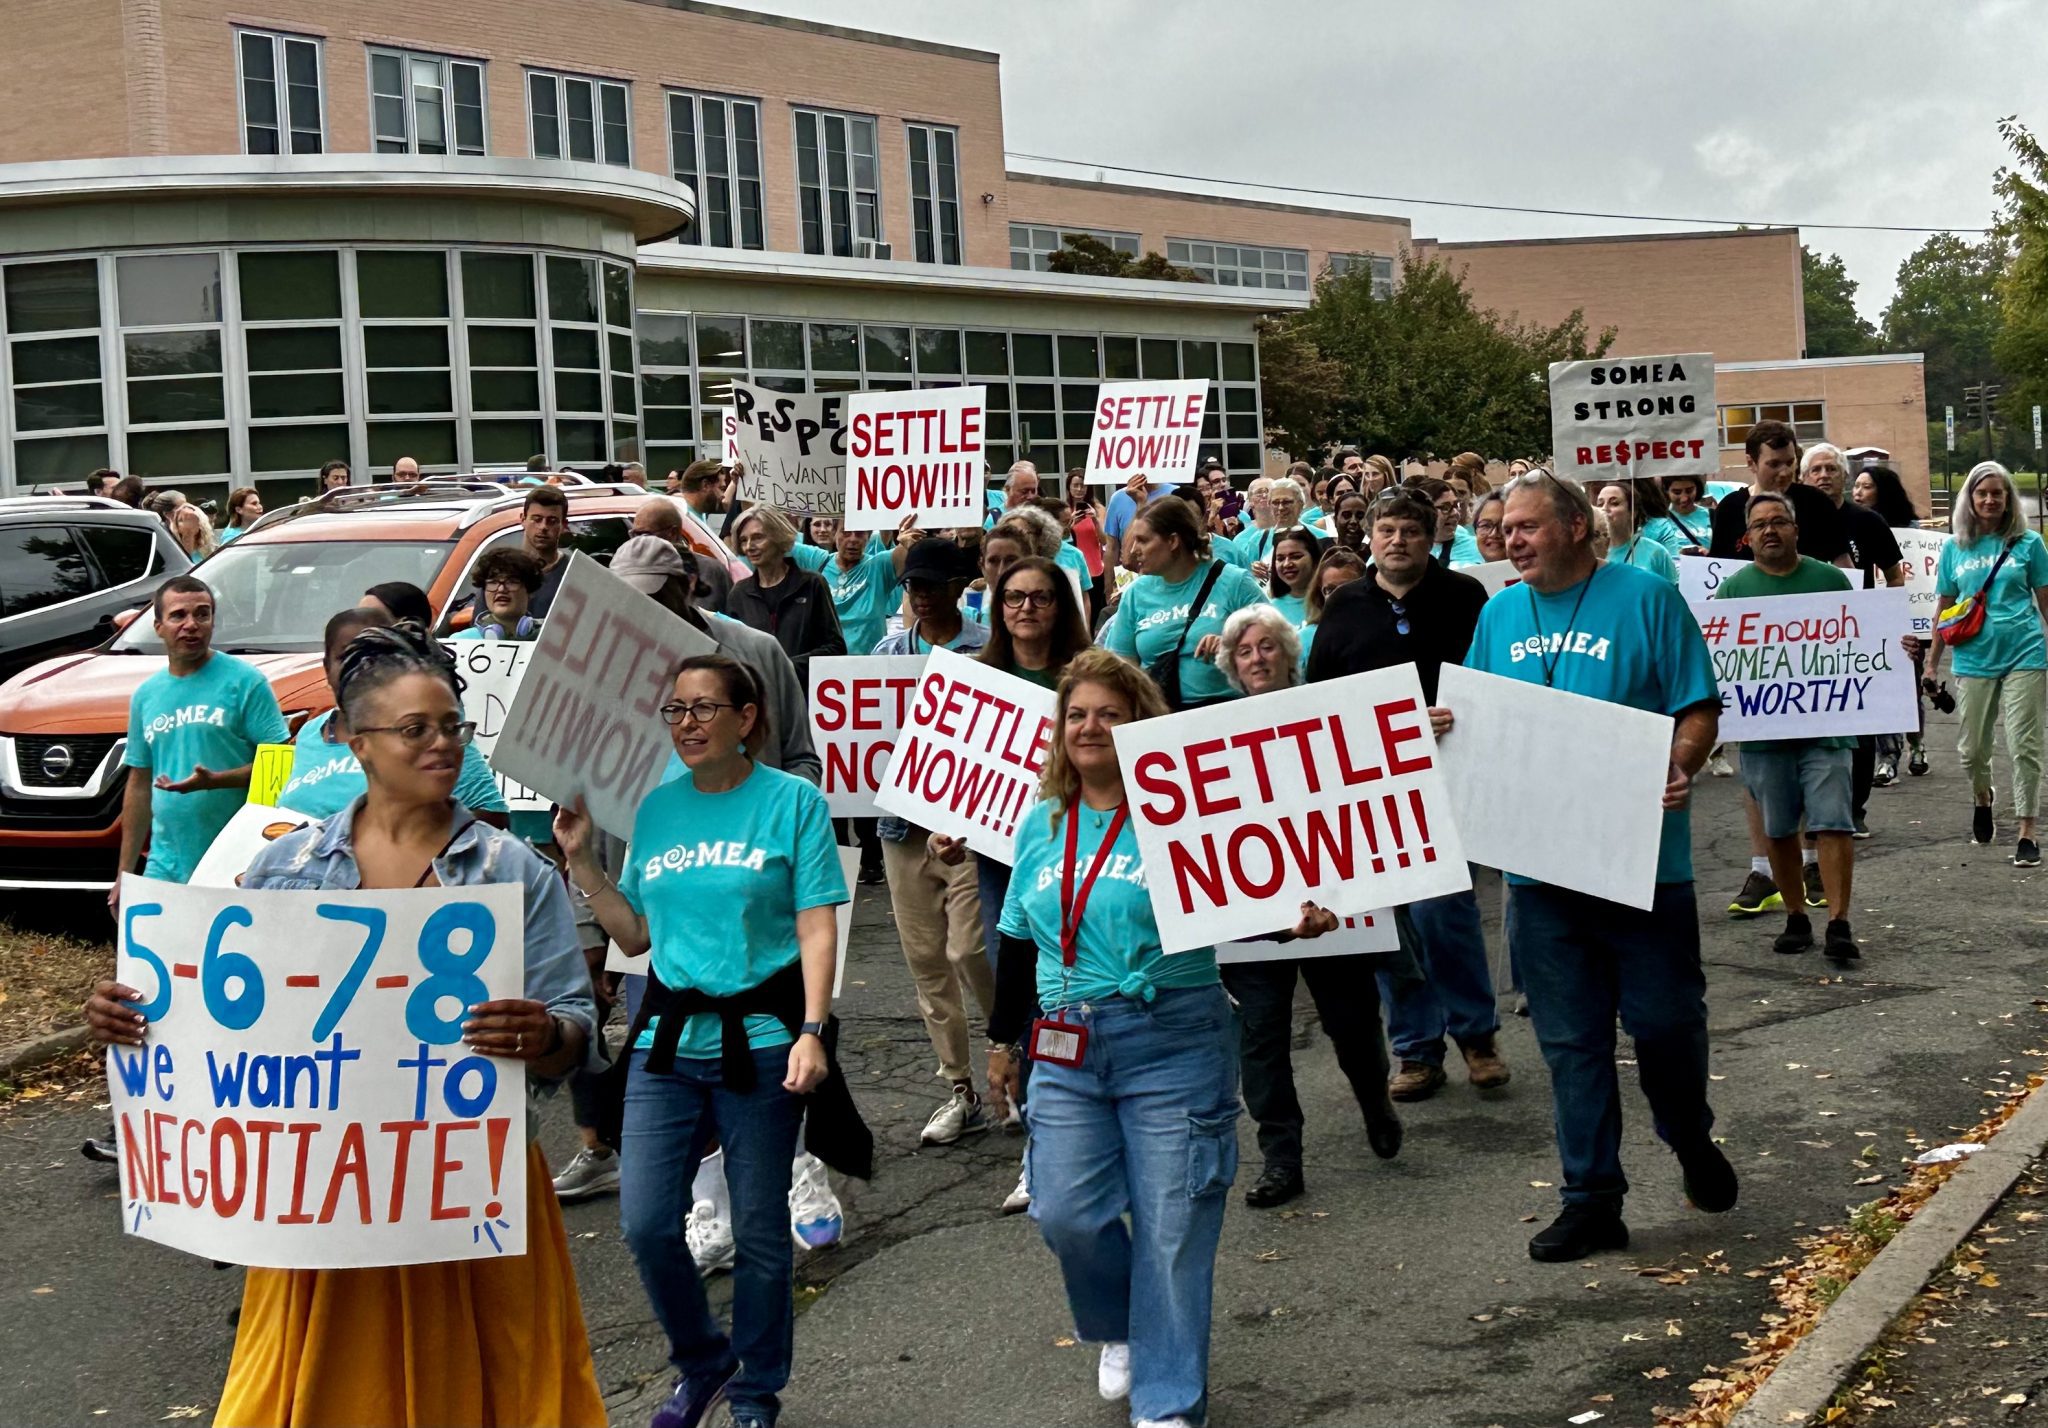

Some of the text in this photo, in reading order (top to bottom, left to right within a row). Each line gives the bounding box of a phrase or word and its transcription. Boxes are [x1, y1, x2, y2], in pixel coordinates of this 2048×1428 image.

[1591, 363, 1686, 385] SOMEA
[734, 388, 847, 456] RESPEC
[1097, 395, 1203, 430] SETTLE
[1574, 395, 1695, 420] STRONG
[852, 407, 980, 458] SETTLE
[1095, 435, 1190, 469] NOW!!!
[1577, 440, 1704, 465] RE$PECT
[744, 450, 845, 485] WE WANT
[857, 462, 971, 510] NOW!!!
[740, 477, 846, 513] WE DESERVE
[1136, 603, 1217, 632] SOMA
[1714, 639, 1892, 682] SOMEA United
[144, 704, 224, 744] SOMEA
[815, 679, 921, 731] SET
[914, 672, 1056, 774] SETTLE
[285, 756, 364, 794] SOME
[1134, 698, 1433, 826] SETTLE
[895, 736, 1029, 837] NOW!!!
[645, 841, 767, 881] SOMEA
[1168, 789, 1437, 914] NOW!!!
[124, 902, 496, 1045] 5-6-7-8
[206, 1033, 361, 1110] want
[398, 1043, 497, 1121] to
[122, 1110, 511, 1225] NEGOTIATE!
